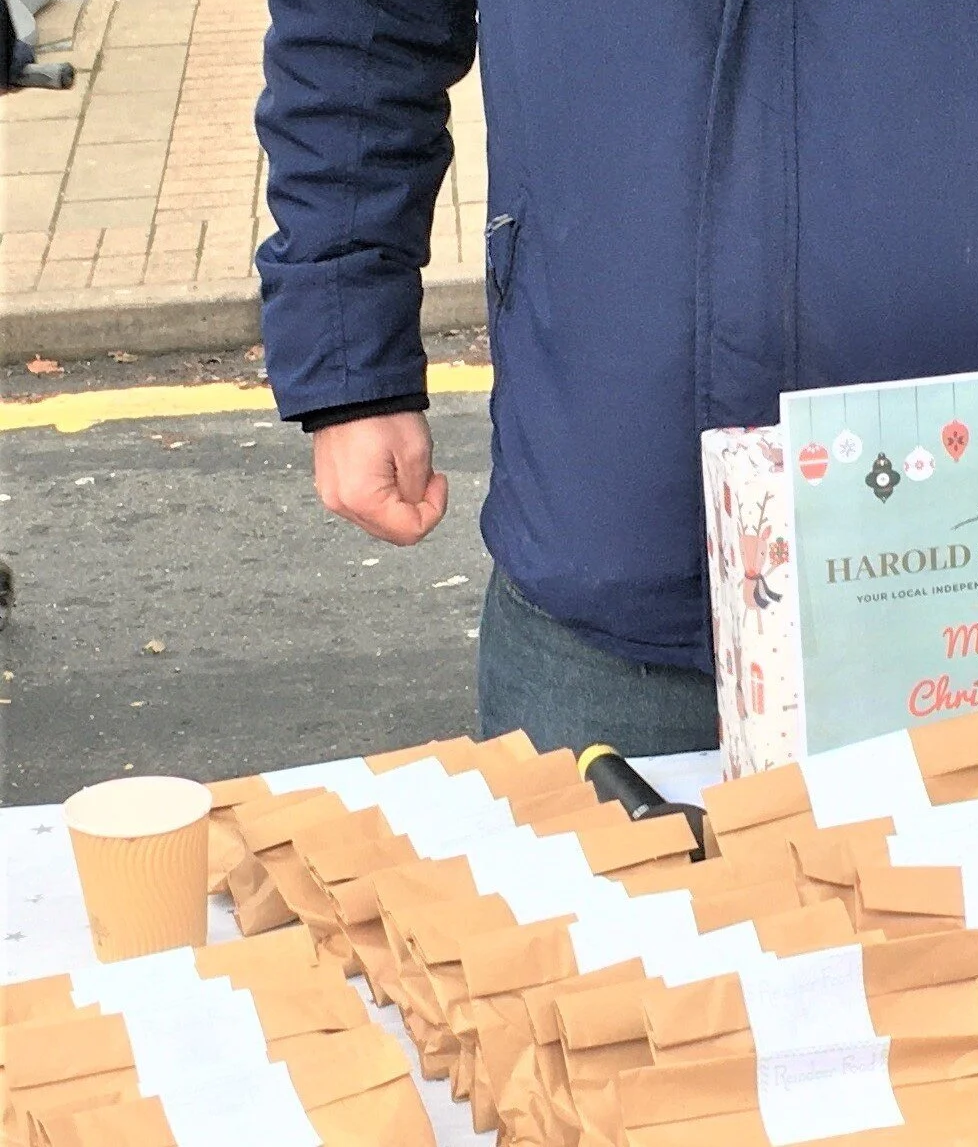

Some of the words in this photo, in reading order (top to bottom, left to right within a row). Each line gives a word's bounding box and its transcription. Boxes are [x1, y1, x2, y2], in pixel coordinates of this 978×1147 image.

[825, 544, 971, 584] HAROLD
[857, 592, 887, 603] YOUR
[892, 588, 928, 599] LOCAL
